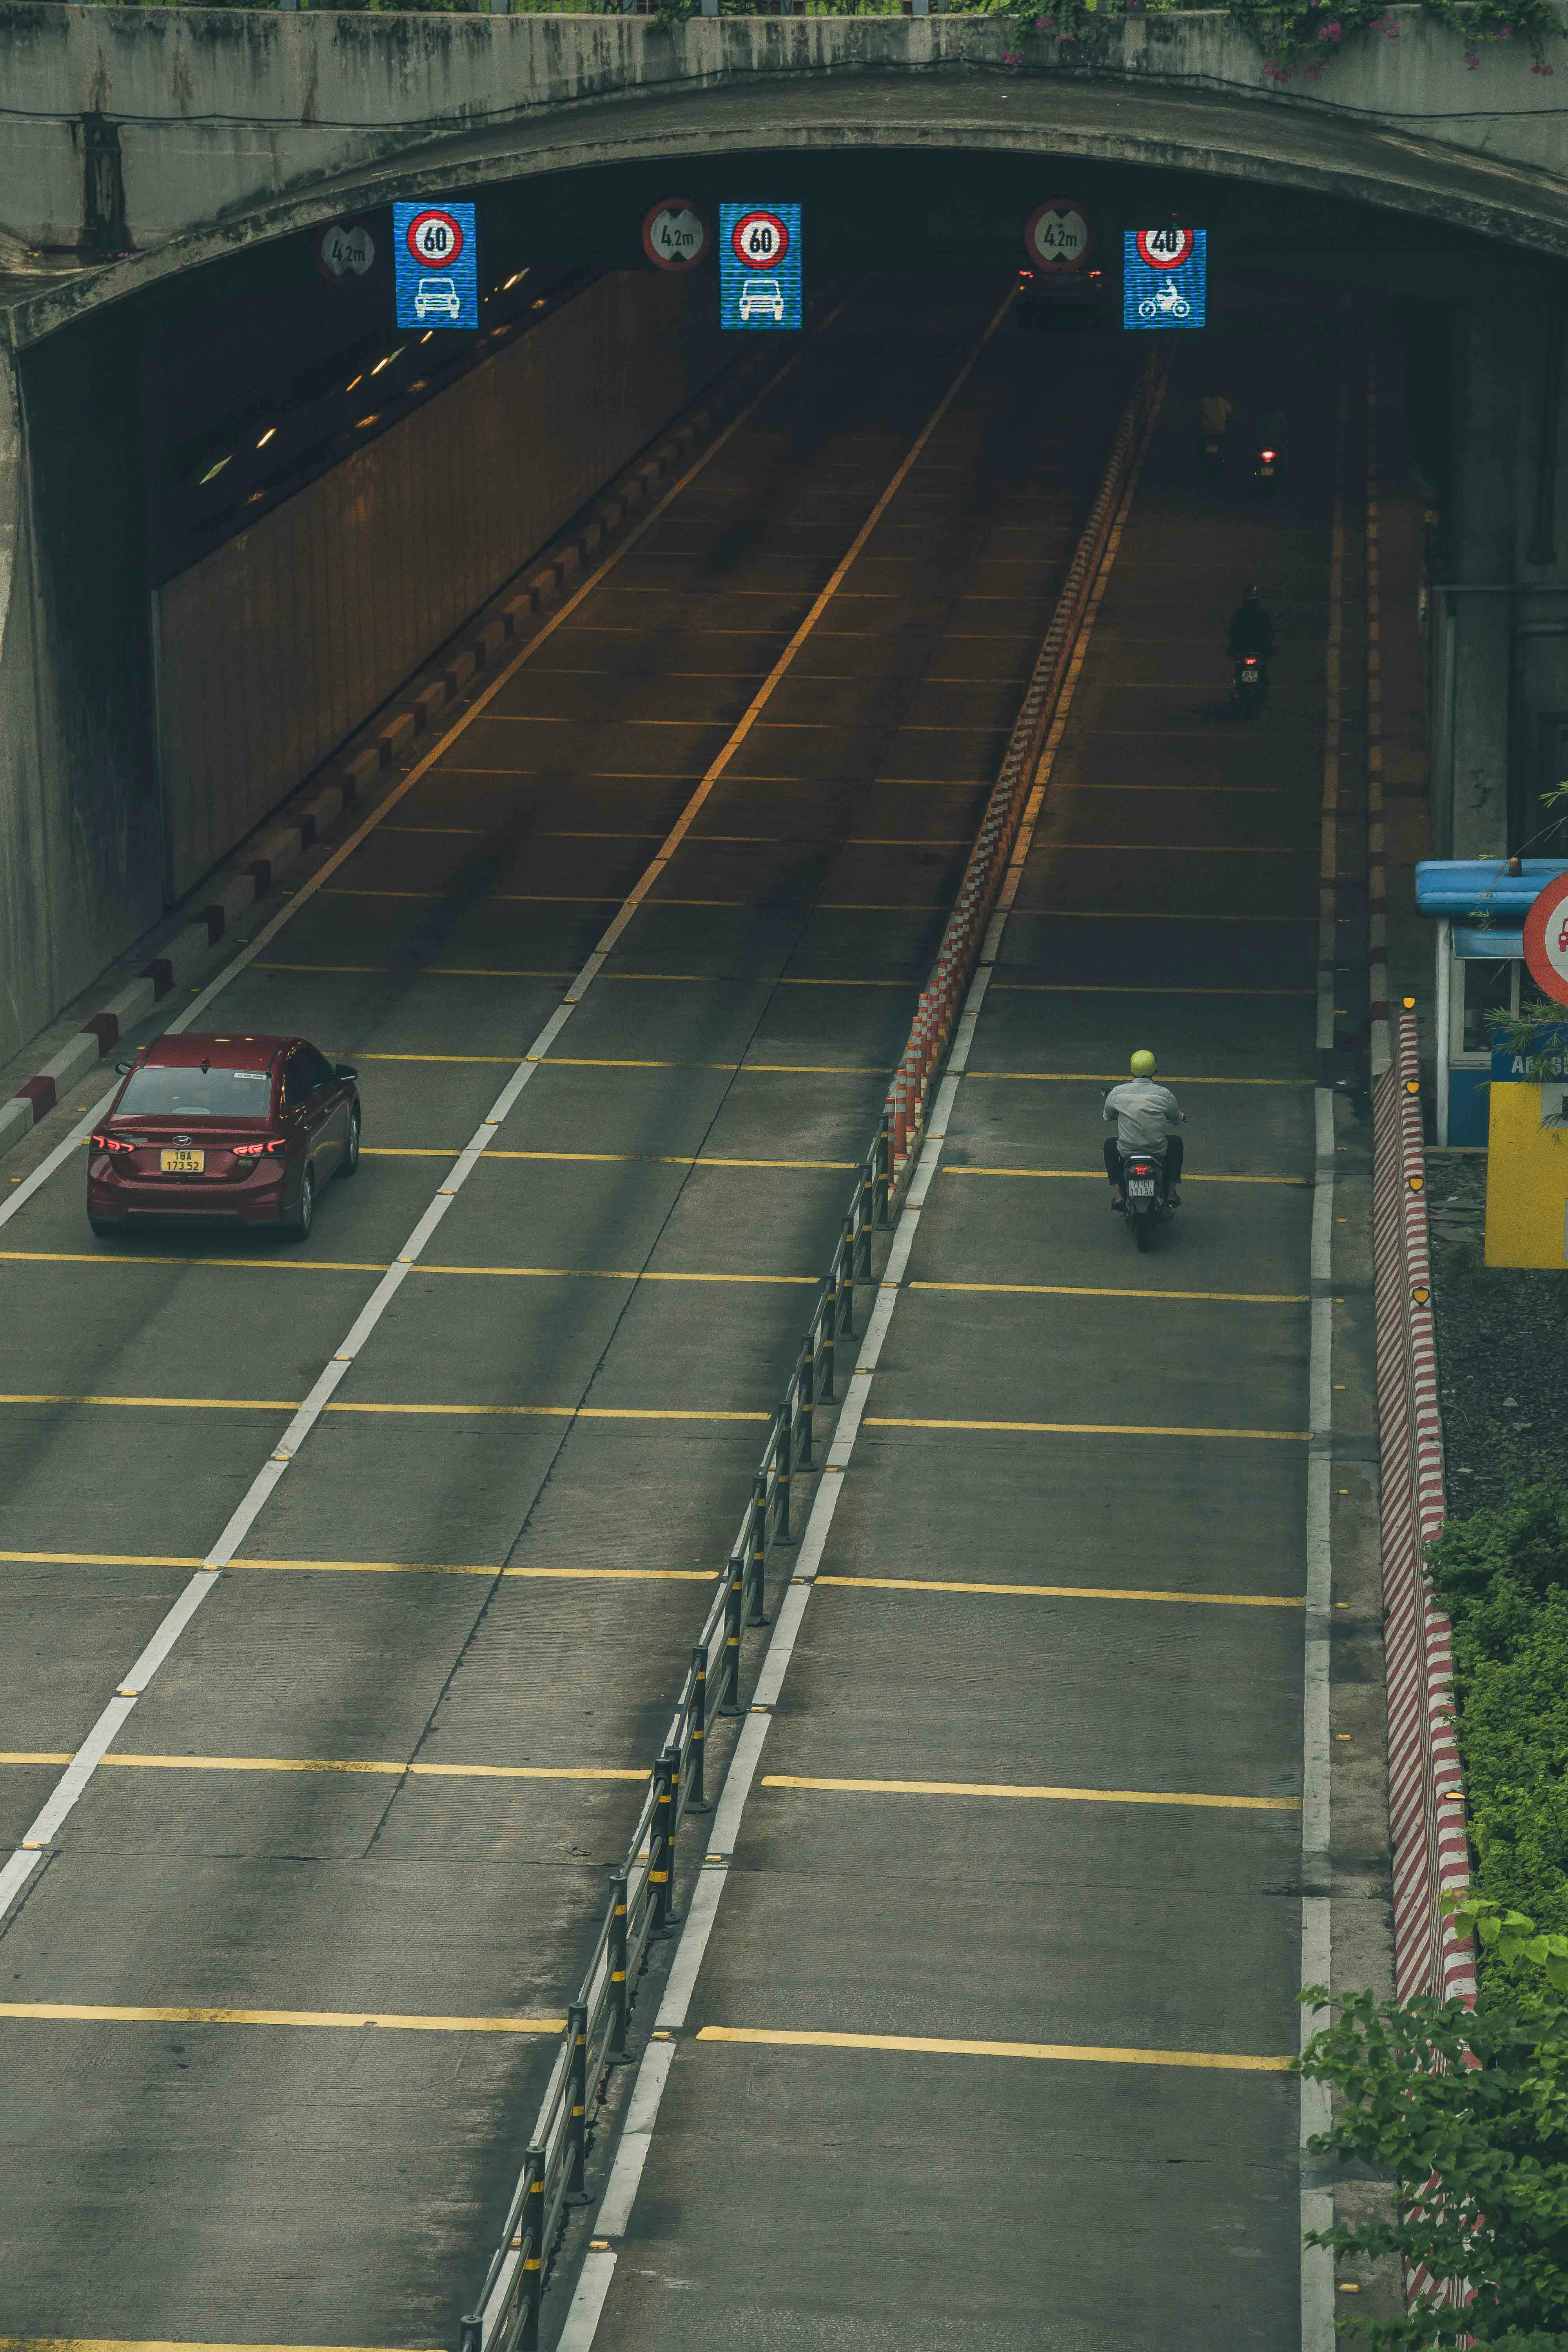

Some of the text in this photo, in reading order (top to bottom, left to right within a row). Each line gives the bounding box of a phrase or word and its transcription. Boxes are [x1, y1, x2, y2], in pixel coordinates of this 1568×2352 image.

[424, 227, 446, 251] 60
[661, 224, 693, 246] 4.2m
[750, 229, 772, 252] 60
[1044, 224, 1077, 246] 4.2m
[1151, 230, 1176, 252] 40
[167, 1161, 199, 1171] 173.52
[175, 1151, 191, 1160] 18A
